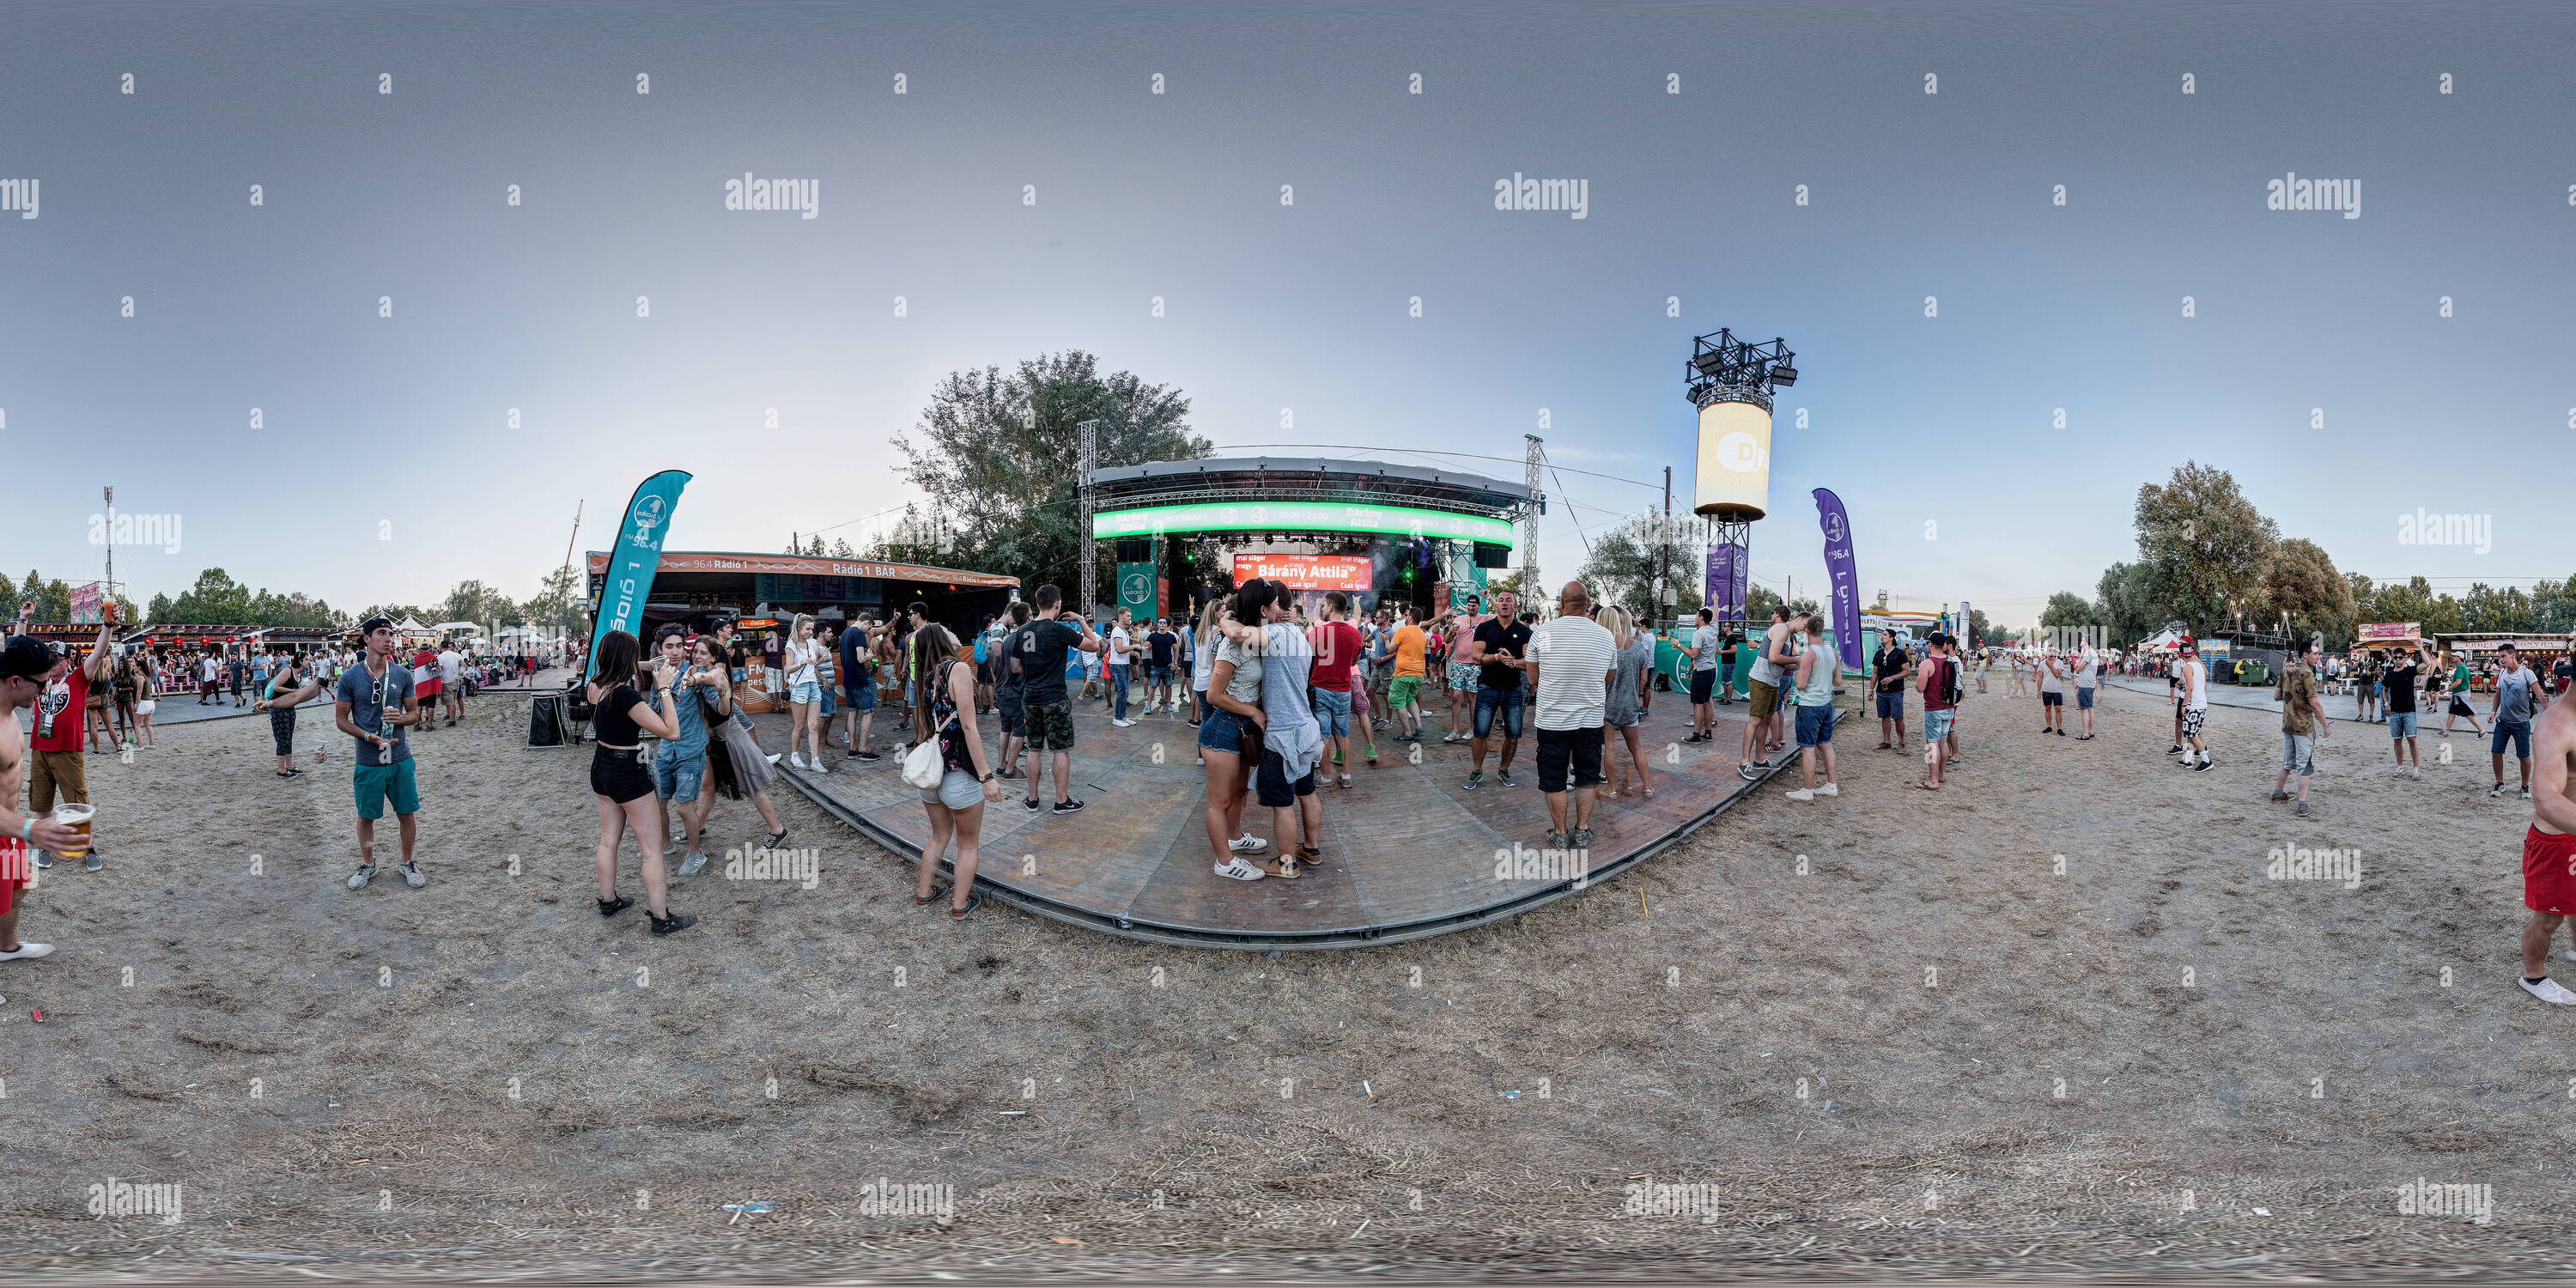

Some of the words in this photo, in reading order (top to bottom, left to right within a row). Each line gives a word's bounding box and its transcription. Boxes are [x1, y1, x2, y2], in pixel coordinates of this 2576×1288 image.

[1346, 507, 1382, 519] Bárány
[1350, 518, 1379, 528] Attila
[632, 536, 658, 550] 96.4
[694, 560, 713, 568] 96.4
[714, 560, 741, 569] Rádió
[743, 561, 748, 569] 1
[833, 563, 863, 576] Rádió
[865, 566, 870, 575] 1
[875, 564, 896, 577] BÁR
[1258, 563, 1306, 580] Bárány
[1309, 565, 1348, 579] Attila
